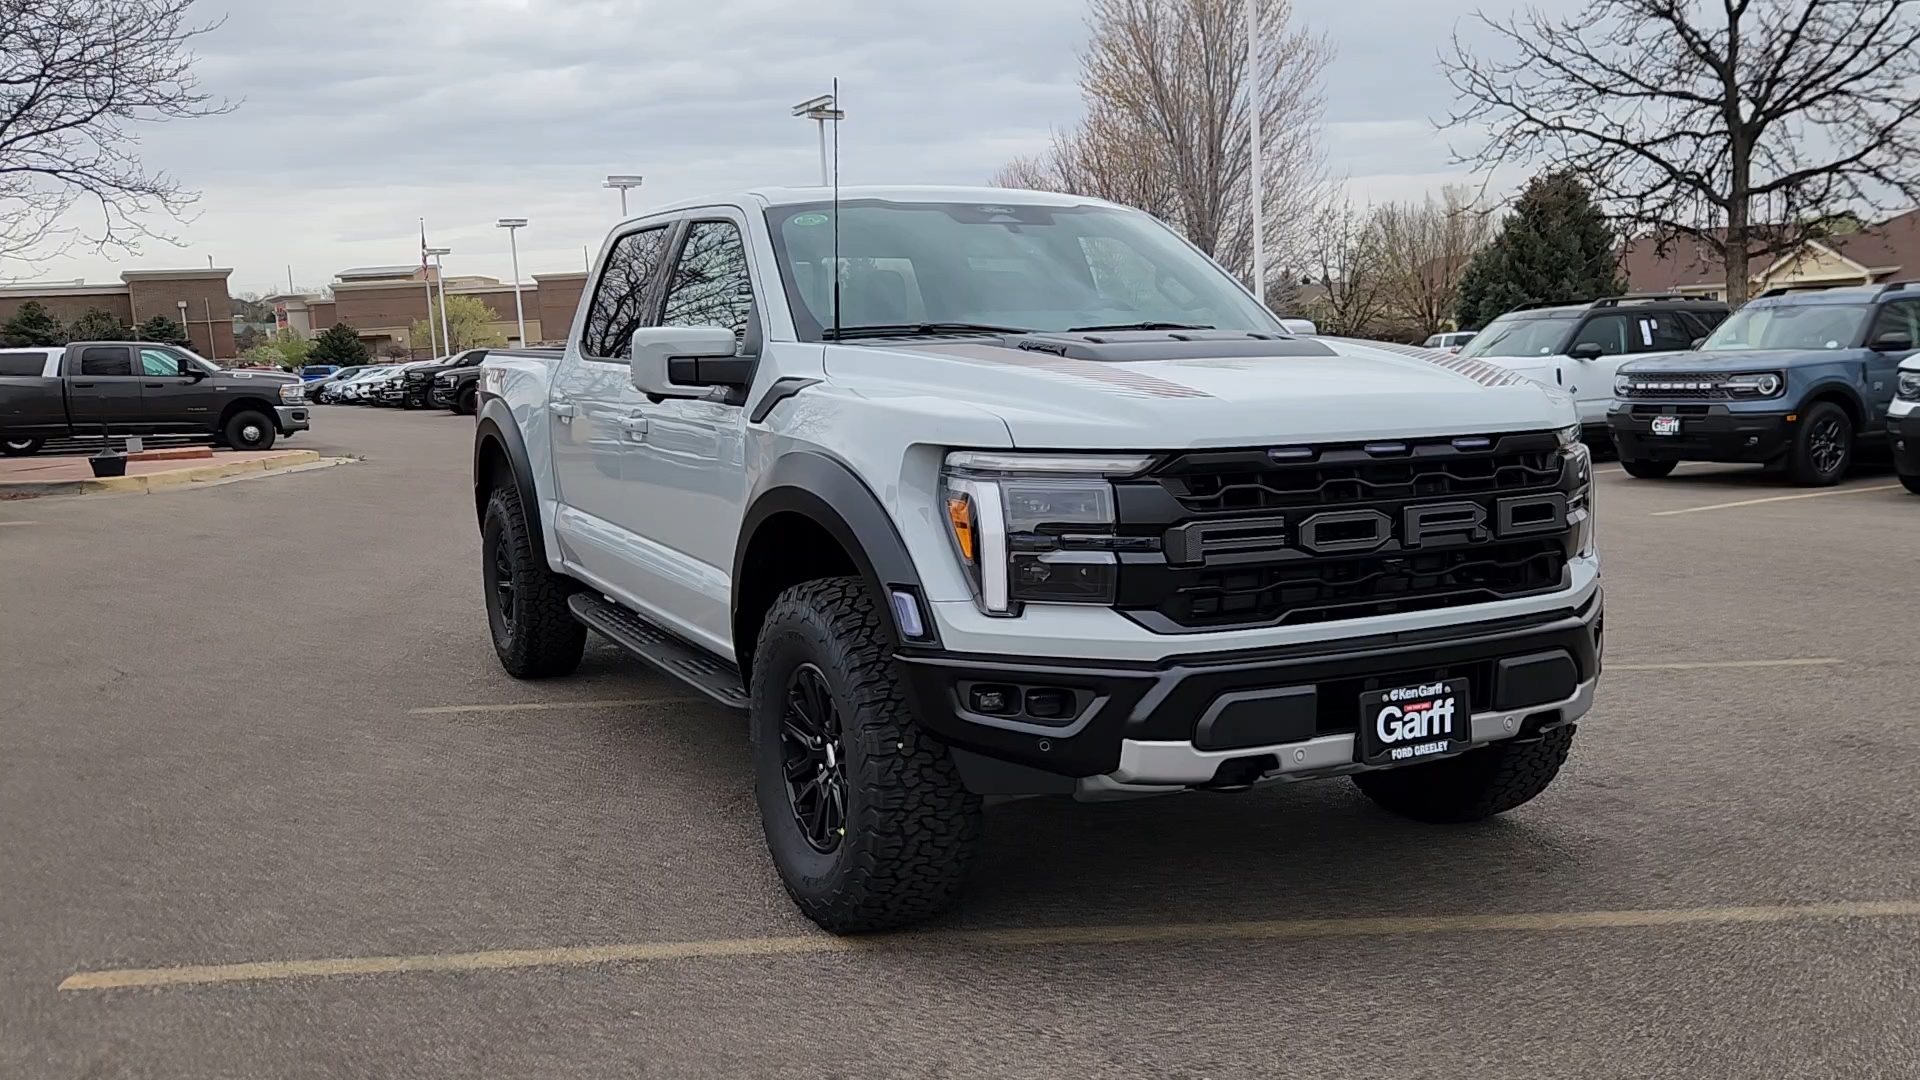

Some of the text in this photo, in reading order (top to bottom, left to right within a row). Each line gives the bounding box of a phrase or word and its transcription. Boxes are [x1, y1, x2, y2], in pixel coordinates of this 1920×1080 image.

[1166, 493, 1568, 569] FORD
[1399, 682, 1443, 701] Ken Garff
[1377, 698, 1454, 743] Garff
[1391, 741, 1448, 760] FORD GREELEY
